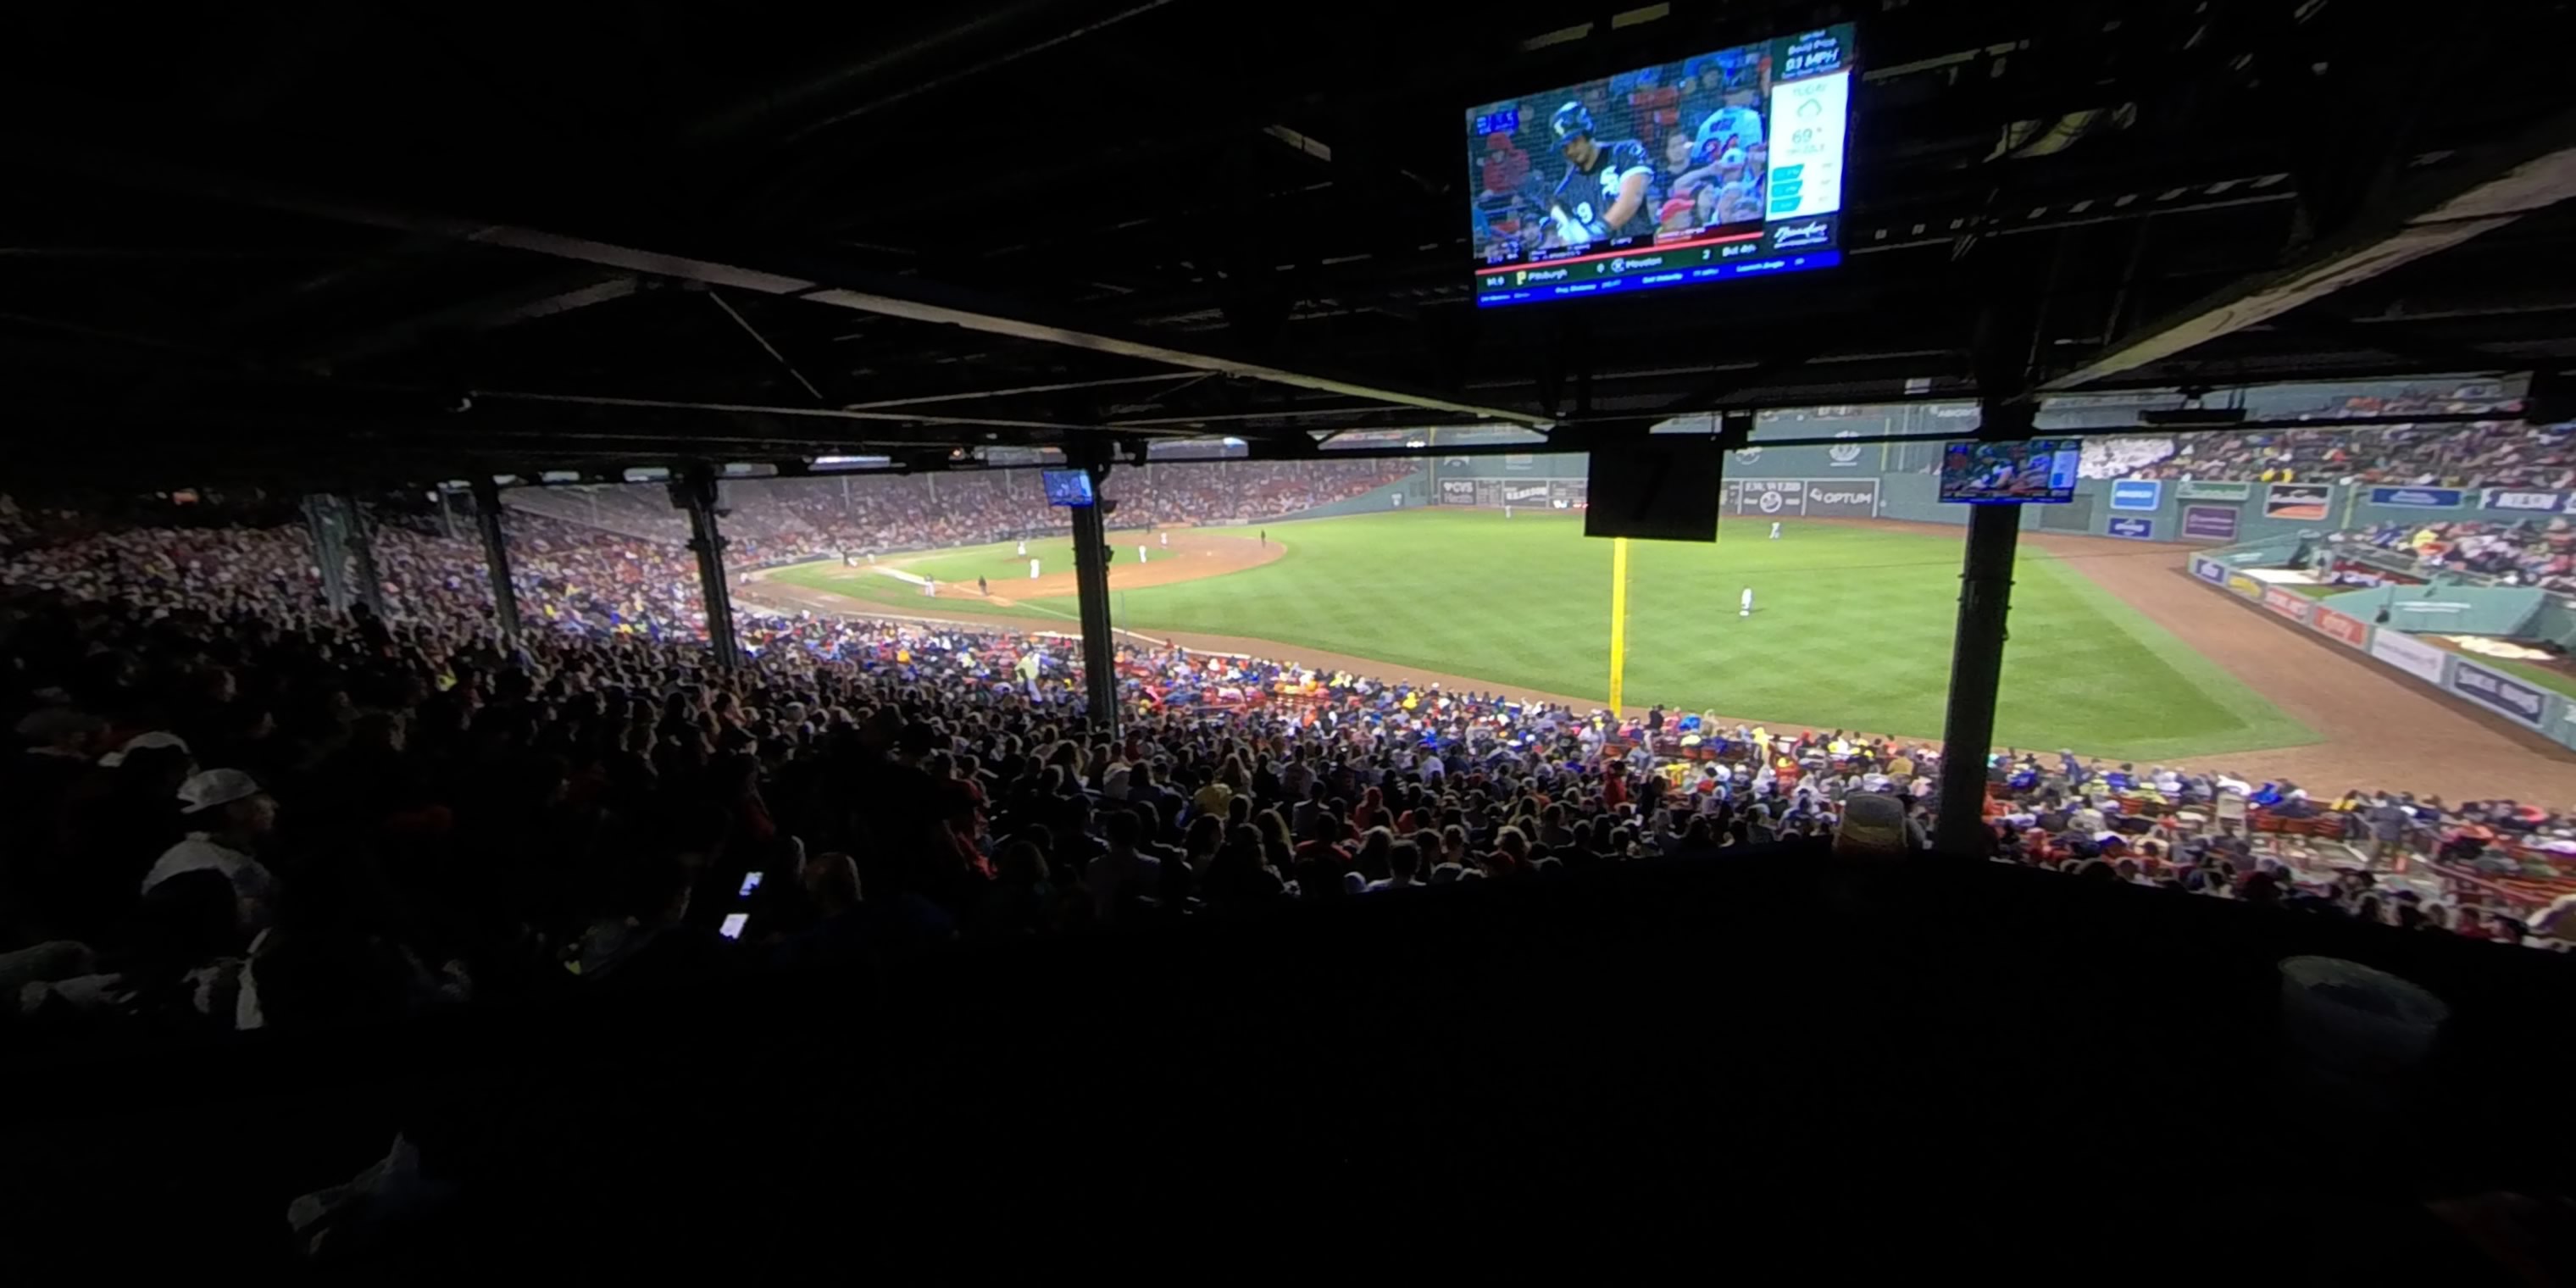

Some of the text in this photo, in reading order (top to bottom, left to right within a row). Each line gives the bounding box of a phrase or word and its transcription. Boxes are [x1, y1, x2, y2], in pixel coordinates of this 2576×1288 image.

[1805, 47, 1839, 68] MPH
[1452, 481, 1474, 493] CVS
[1629, 448, 1675, 523] 7
[1823, 491, 1873, 504] OPTUM
